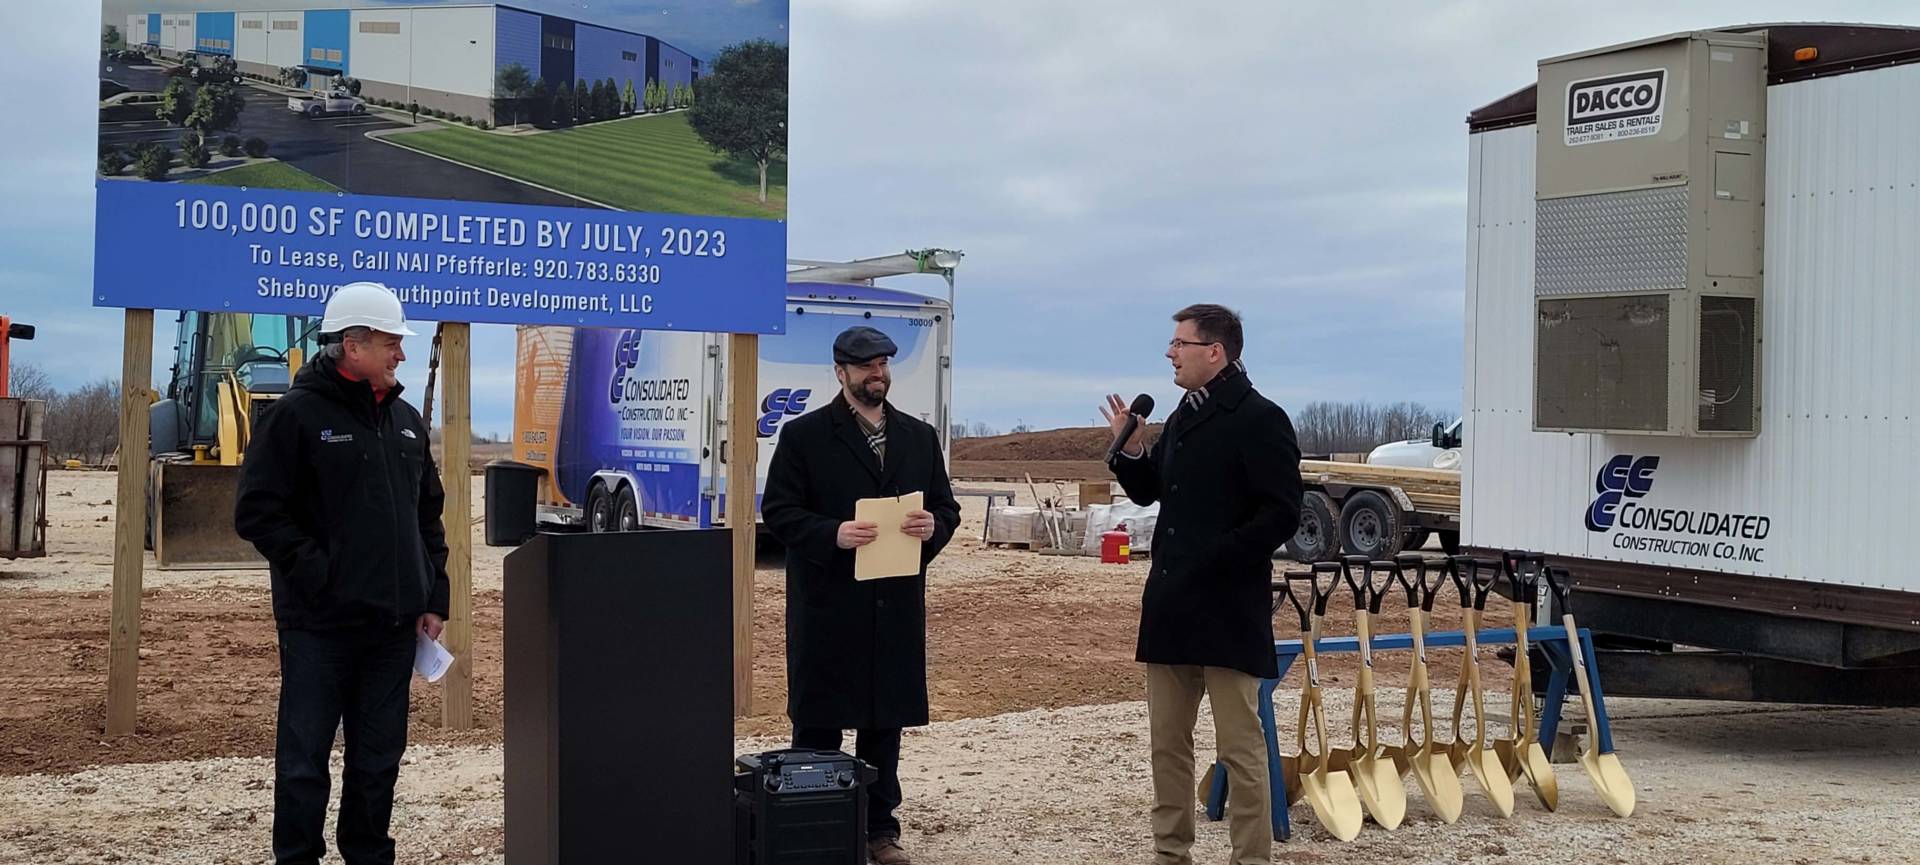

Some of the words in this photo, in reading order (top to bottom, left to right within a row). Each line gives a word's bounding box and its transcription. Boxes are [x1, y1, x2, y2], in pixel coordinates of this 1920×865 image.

[1576, 84, 1653, 113] DACCO
[1566, 124, 1594, 136] TRAILER
[1594, 121, 1617, 132] SALES
[1619, 119, 1625, 128] &
[1626, 115, 1660, 127] RENTALS
[174, 199, 298, 237] 100,000
[308, 207, 345, 236] SF
[353, 209, 526, 247] COMPLETED
[536, 220, 573, 250] BY
[580, 223, 652, 259] JULY,
[660, 227, 727, 258] 2023
[249, 244, 272, 265] To
[279, 246, 346, 272] Lease,
[351, 250, 390, 271] Call
[395, 252, 431, 273] NAI
[435, 254, 528, 279] Pfefferle:
[533, 259, 661, 284] 920.783.6330
[256, 277, 339, 304] Sheboy
[378, 282, 482, 309] outhpoint
[486, 287, 614, 314] Development,
[619, 293, 653, 314] LLC
[625, 376, 689, 401] CONSOLIDATED
[622, 406, 663, 421] CONSTRUCTION
[1619, 502, 1771, 540] CONSOLIDATED
[1612, 532, 1710, 558] CONSTRUCTION
